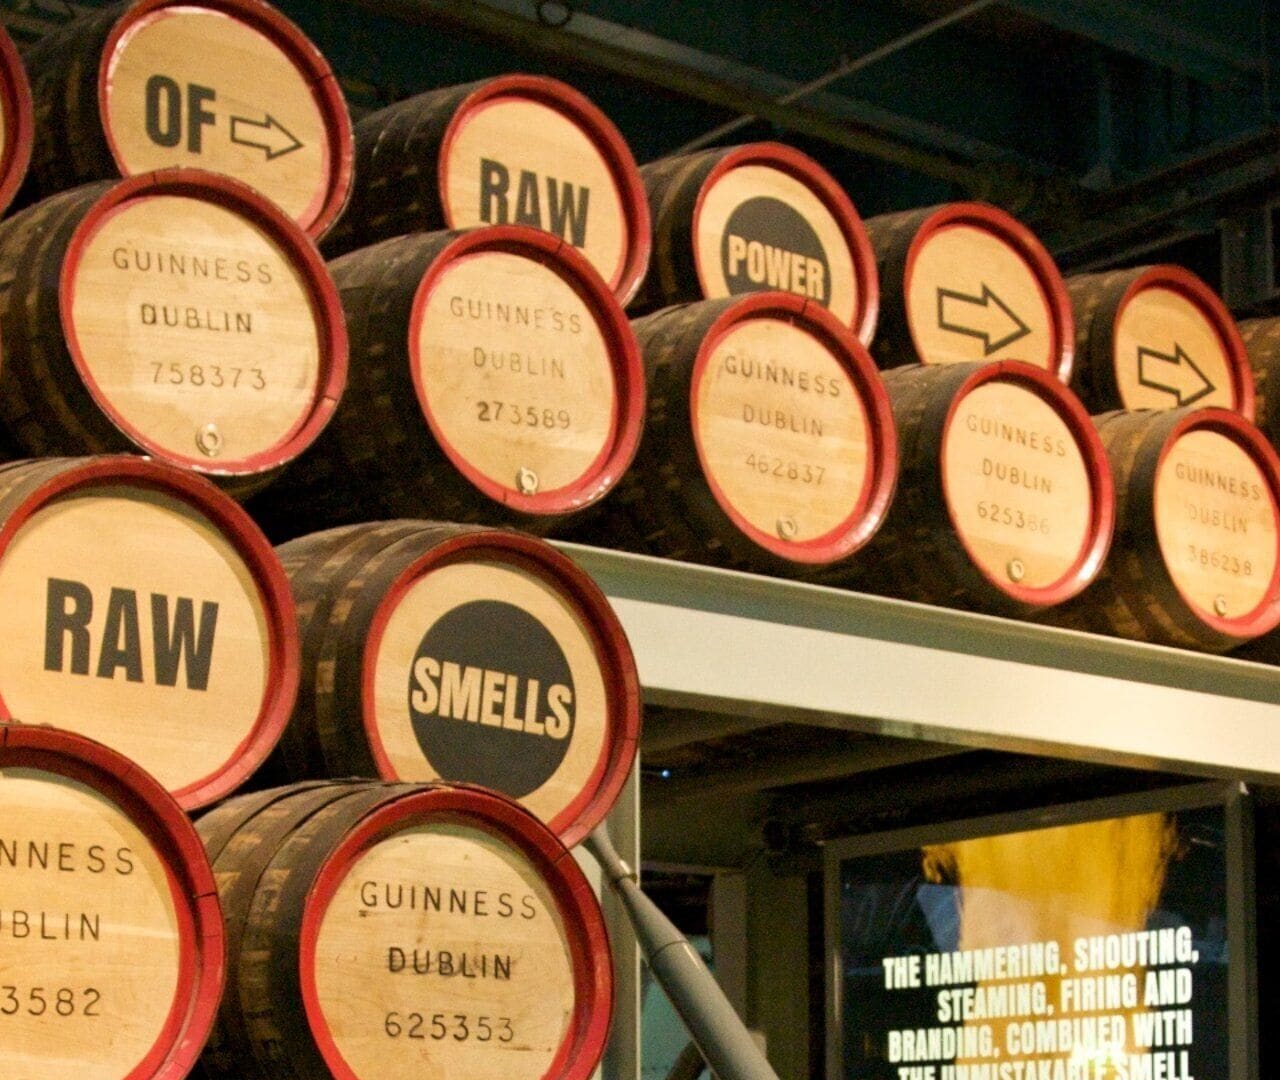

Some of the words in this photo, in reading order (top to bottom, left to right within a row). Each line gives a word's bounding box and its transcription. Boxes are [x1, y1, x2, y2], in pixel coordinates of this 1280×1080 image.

[145, 74, 216, 153] OF
[479, 157, 590, 249] RAW
[113, 246, 273, 286] GUINNESS
[728, 234, 825, 301] POWER
[140, 303, 253, 334] DUBLIN
[450, 295, 582, 335] GUINNESS
[151, 359, 267, 391] 758373
[472, 345, 565, 379] DUBLIN
[725, 355, 841, 397] GUINNESS
[477, 401, 572, 430] 273589
[742, 403, 824, 437] DUBLIN
[966, 414, 1066, 457] GUINNESS
[746, 454, 825, 485] 462837
[982, 458, 1052, 494] DUBLIN
[1175, 463, 1261, 501] GUINNESS
[1188, 503, 1248, 534] DUBLIN
[44, 577, 219, 691] RAW
[411, 656, 573, 739] SMELLS
[359, 881, 537, 921] GUINNESS
[387, 947, 512, 981] DUBLIN
[882, 955, 921, 989] THE
[925, 941, 1067, 986] HAMMERING,
[1074, 926, 1199, 972] SHOUTING,
[937, 982, 1054, 1022] STEAMING,
[1061, 973, 1137, 1013] FIRING
[1144, 968, 1193, 1006] AND
[385, 1013, 515, 1043] 625353
[888, 1025, 1000, 1063] BRANDING,
[1006, 1015, 1126, 1056] COMBINED
[1133, 1009, 1193, 1047] WITH
